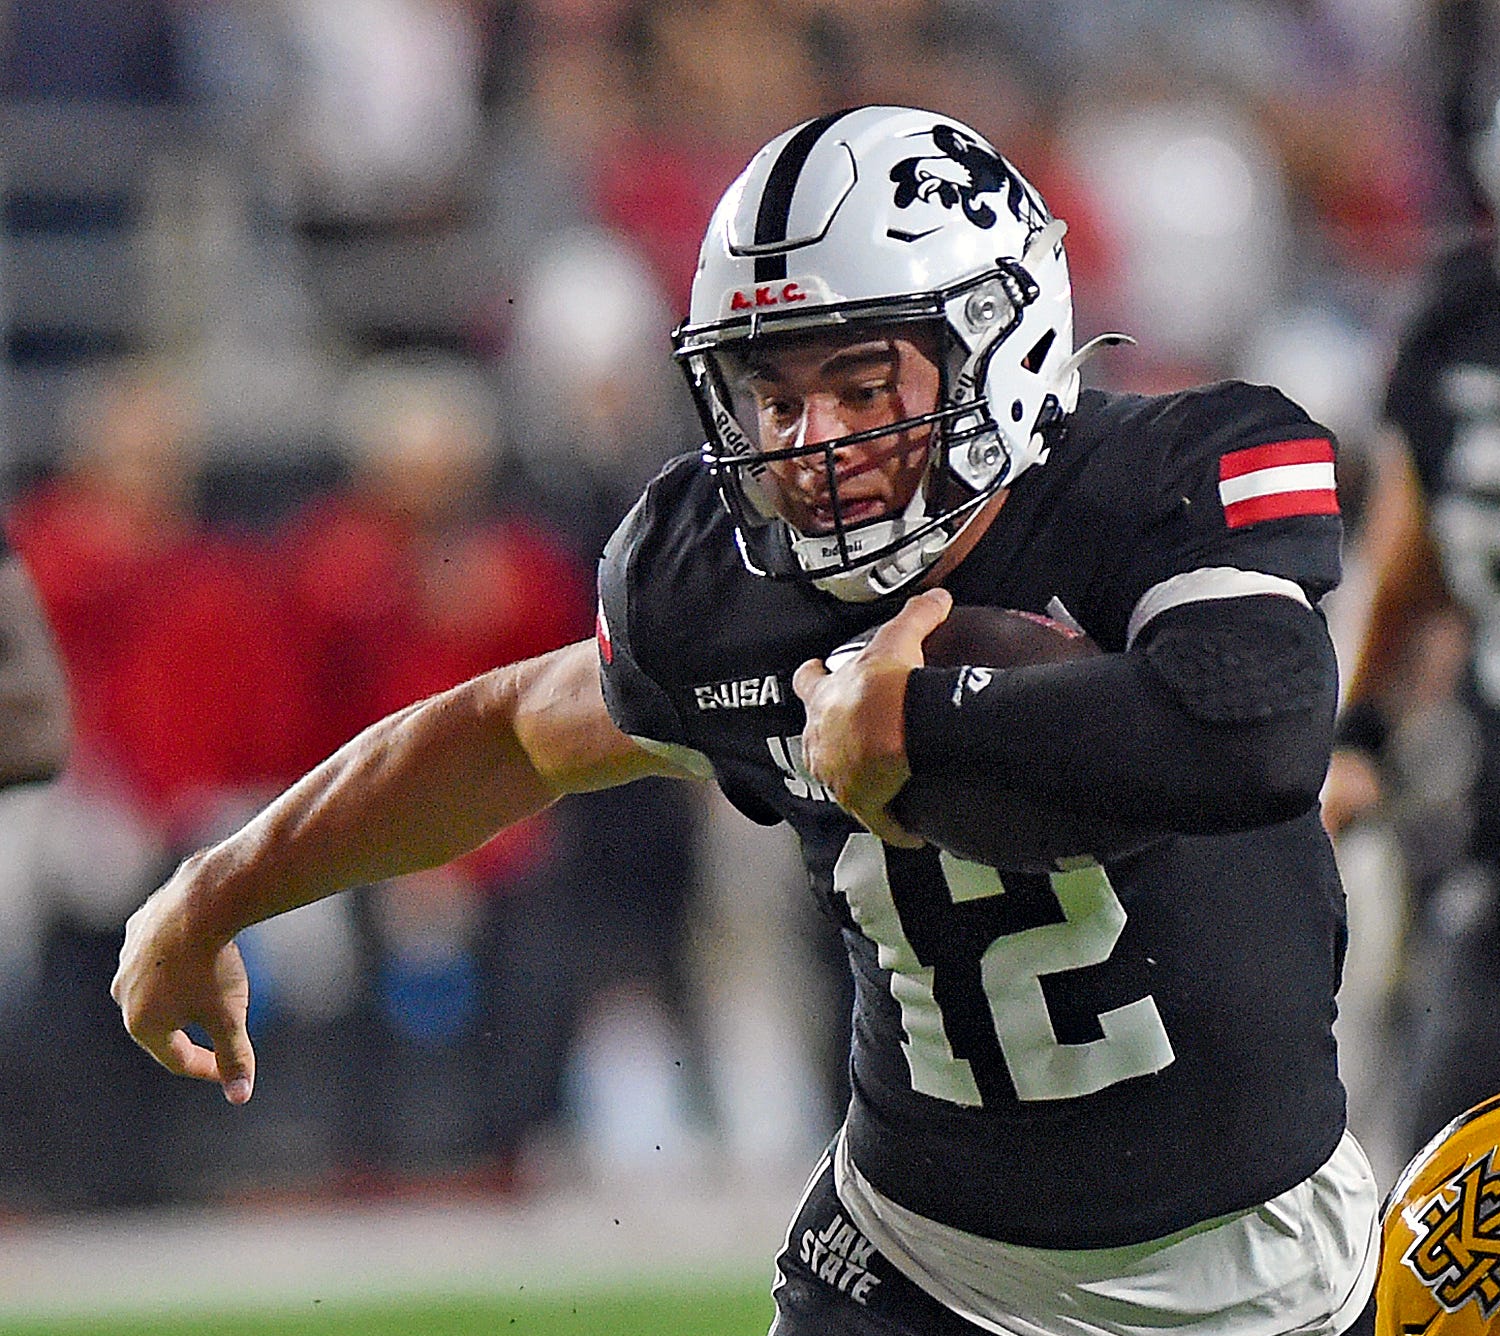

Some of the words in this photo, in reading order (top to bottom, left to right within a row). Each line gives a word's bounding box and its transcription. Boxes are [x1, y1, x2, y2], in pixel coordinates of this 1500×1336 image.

[833, 832, 1176, 1107] 12
[799, 1229, 882, 1307] STATE
[818, 1213, 879, 1271] JAX
